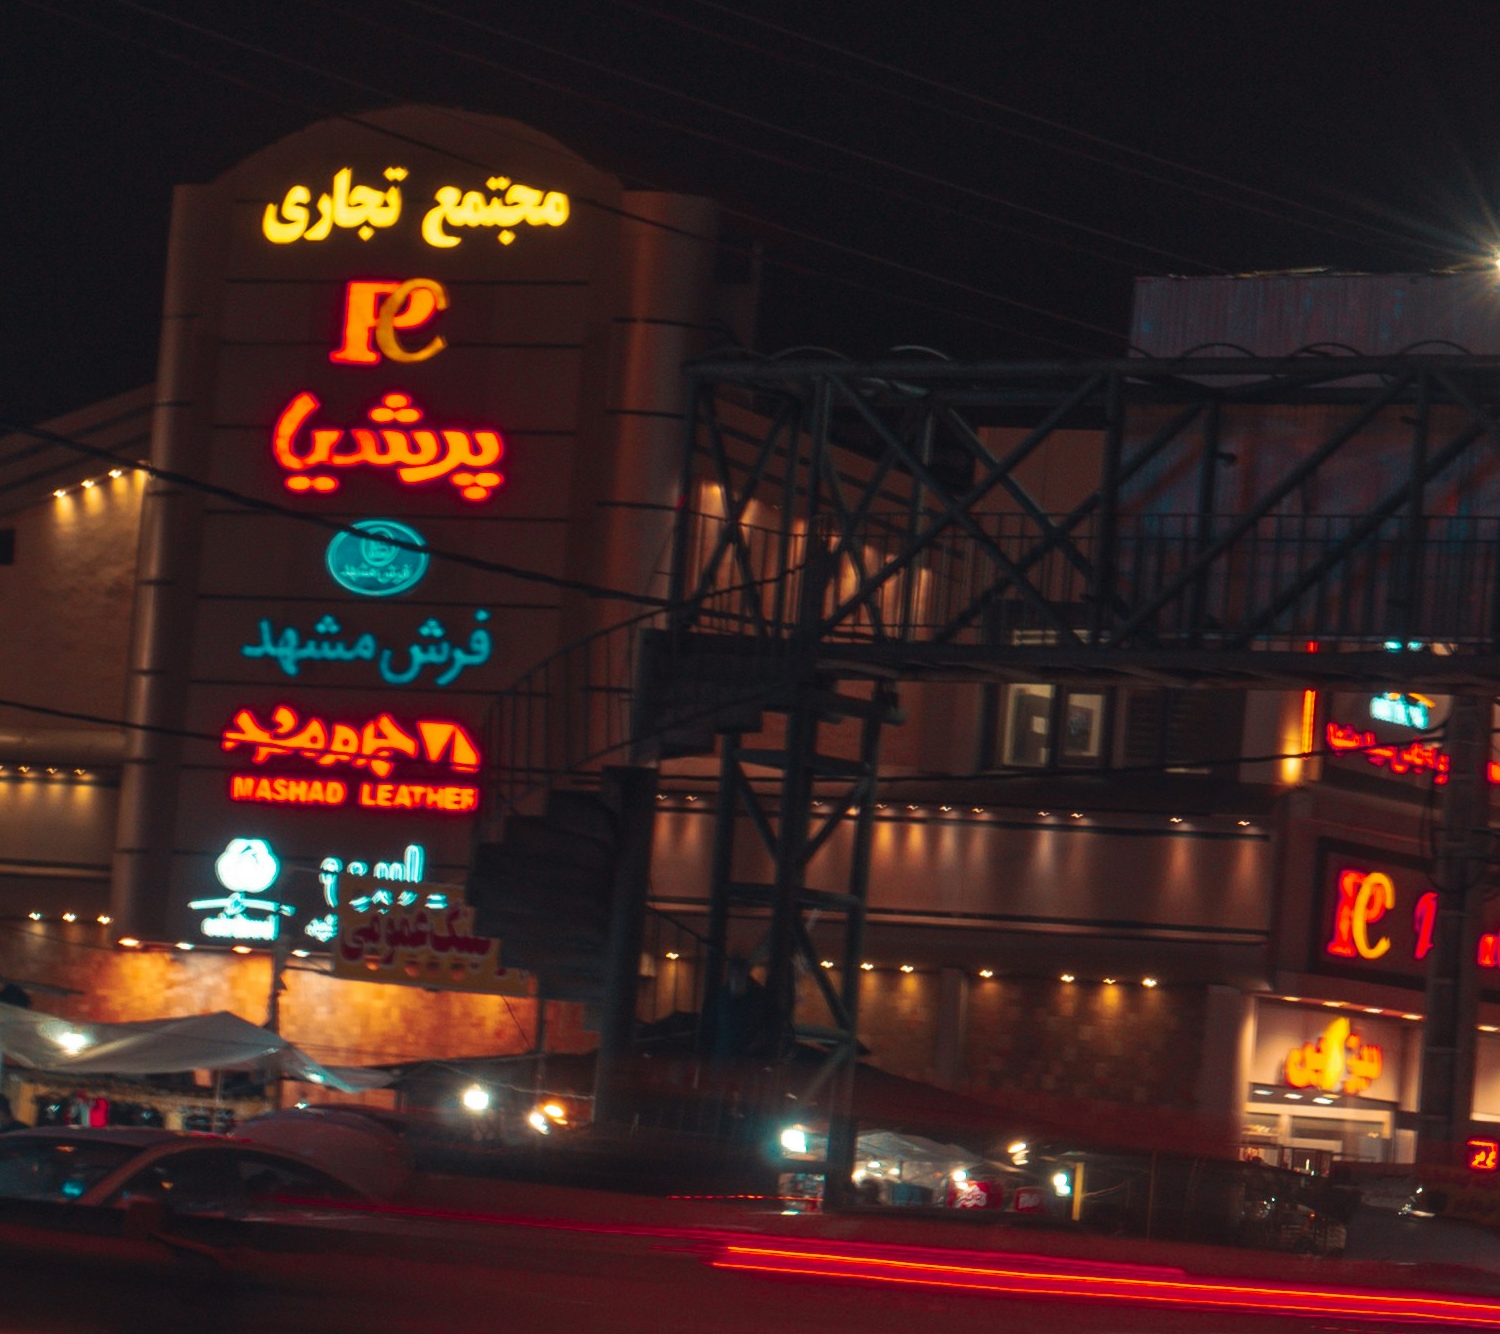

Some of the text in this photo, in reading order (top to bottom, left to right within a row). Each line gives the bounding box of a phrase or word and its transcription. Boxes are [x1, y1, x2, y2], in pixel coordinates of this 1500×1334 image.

[261, 166, 570, 249] مجتمع تجاری
[272, 392, 504, 501] پرشیا
[240, 609, 493, 685] فرش مشهد
[230, 775, 480, 813] MASHAD LEATHER
